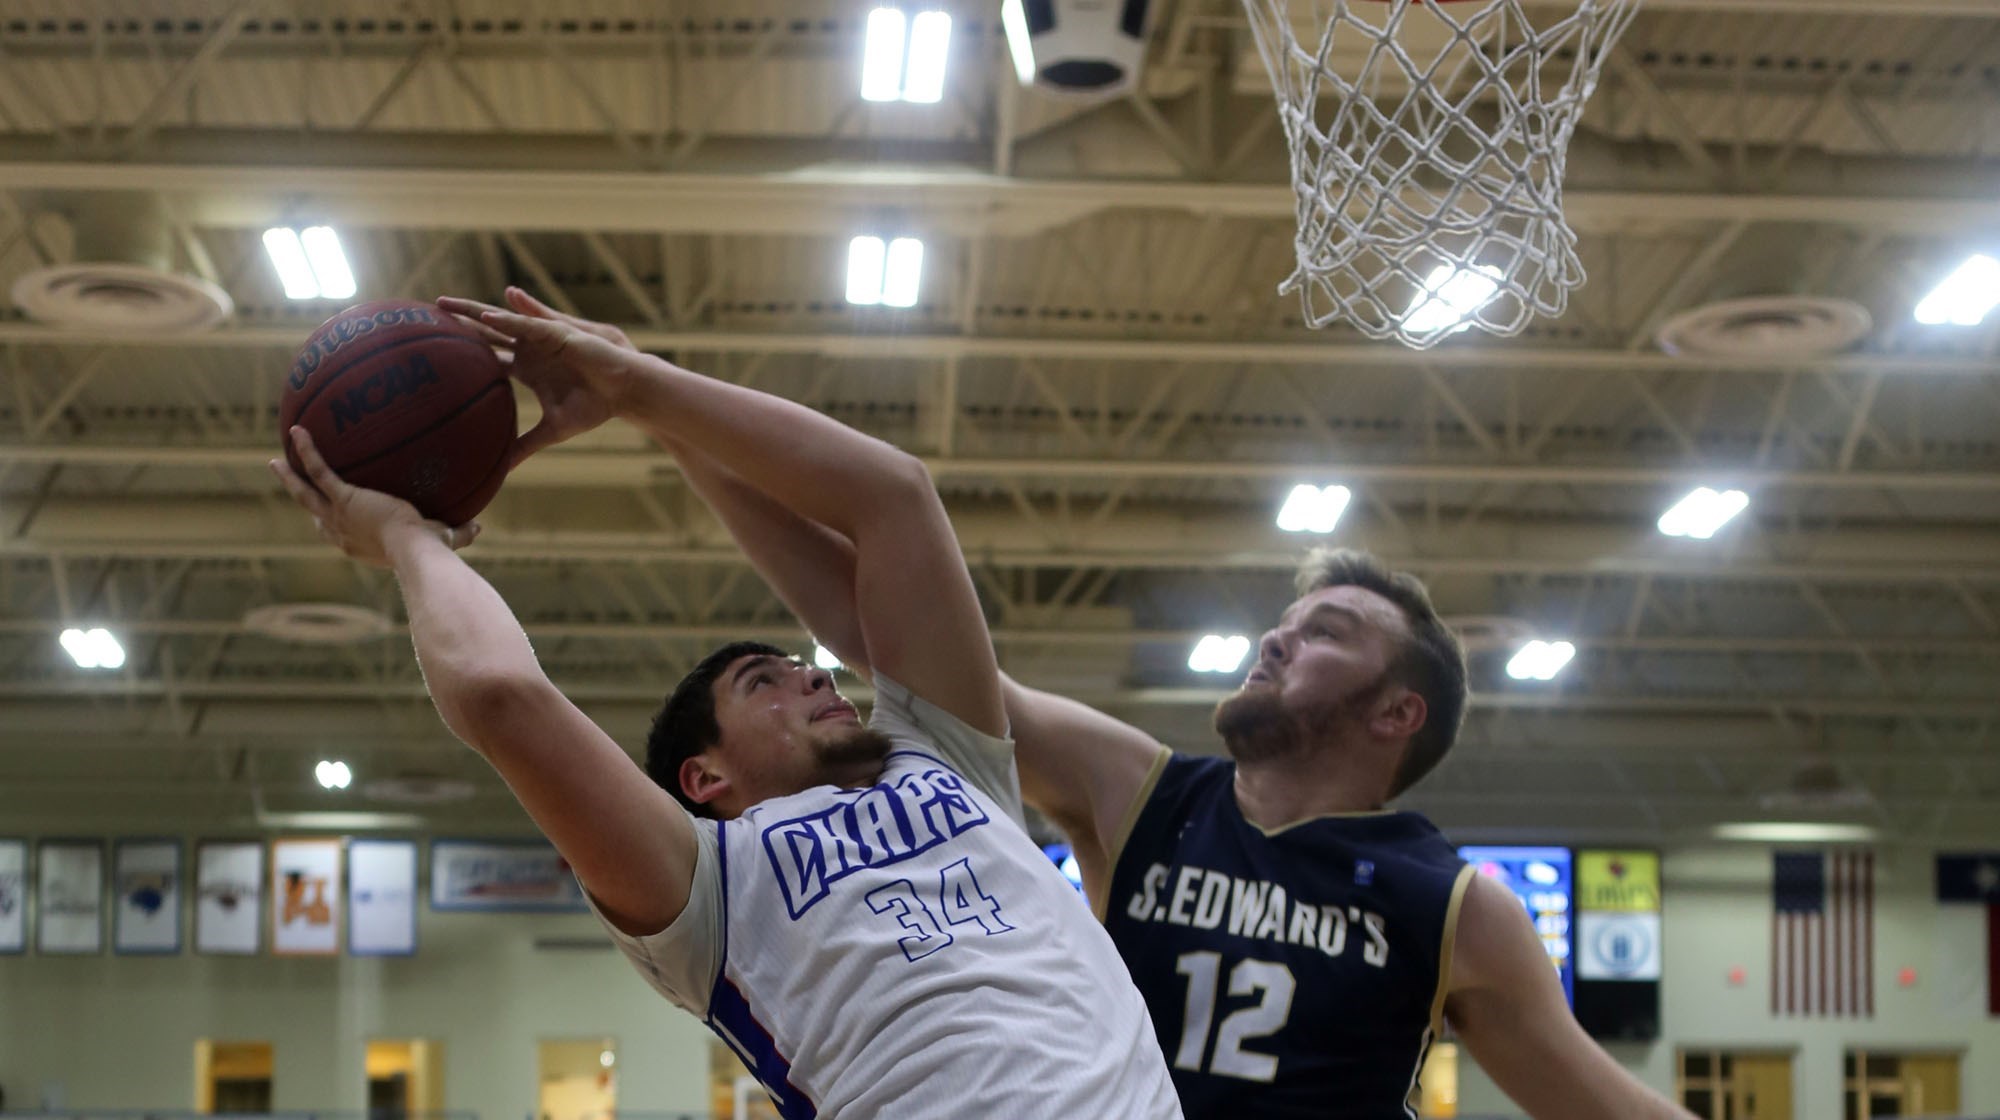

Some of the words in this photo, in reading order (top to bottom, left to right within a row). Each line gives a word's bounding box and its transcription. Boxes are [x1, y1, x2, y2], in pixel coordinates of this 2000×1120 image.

[289, 308, 438, 390] Wilson
[329, 355, 439, 434] NCAA
[762, 770, 990, 921] CHAPS
[864, 857, 1016, 963] 34
[1174, 950, 1297, 1083] 12
